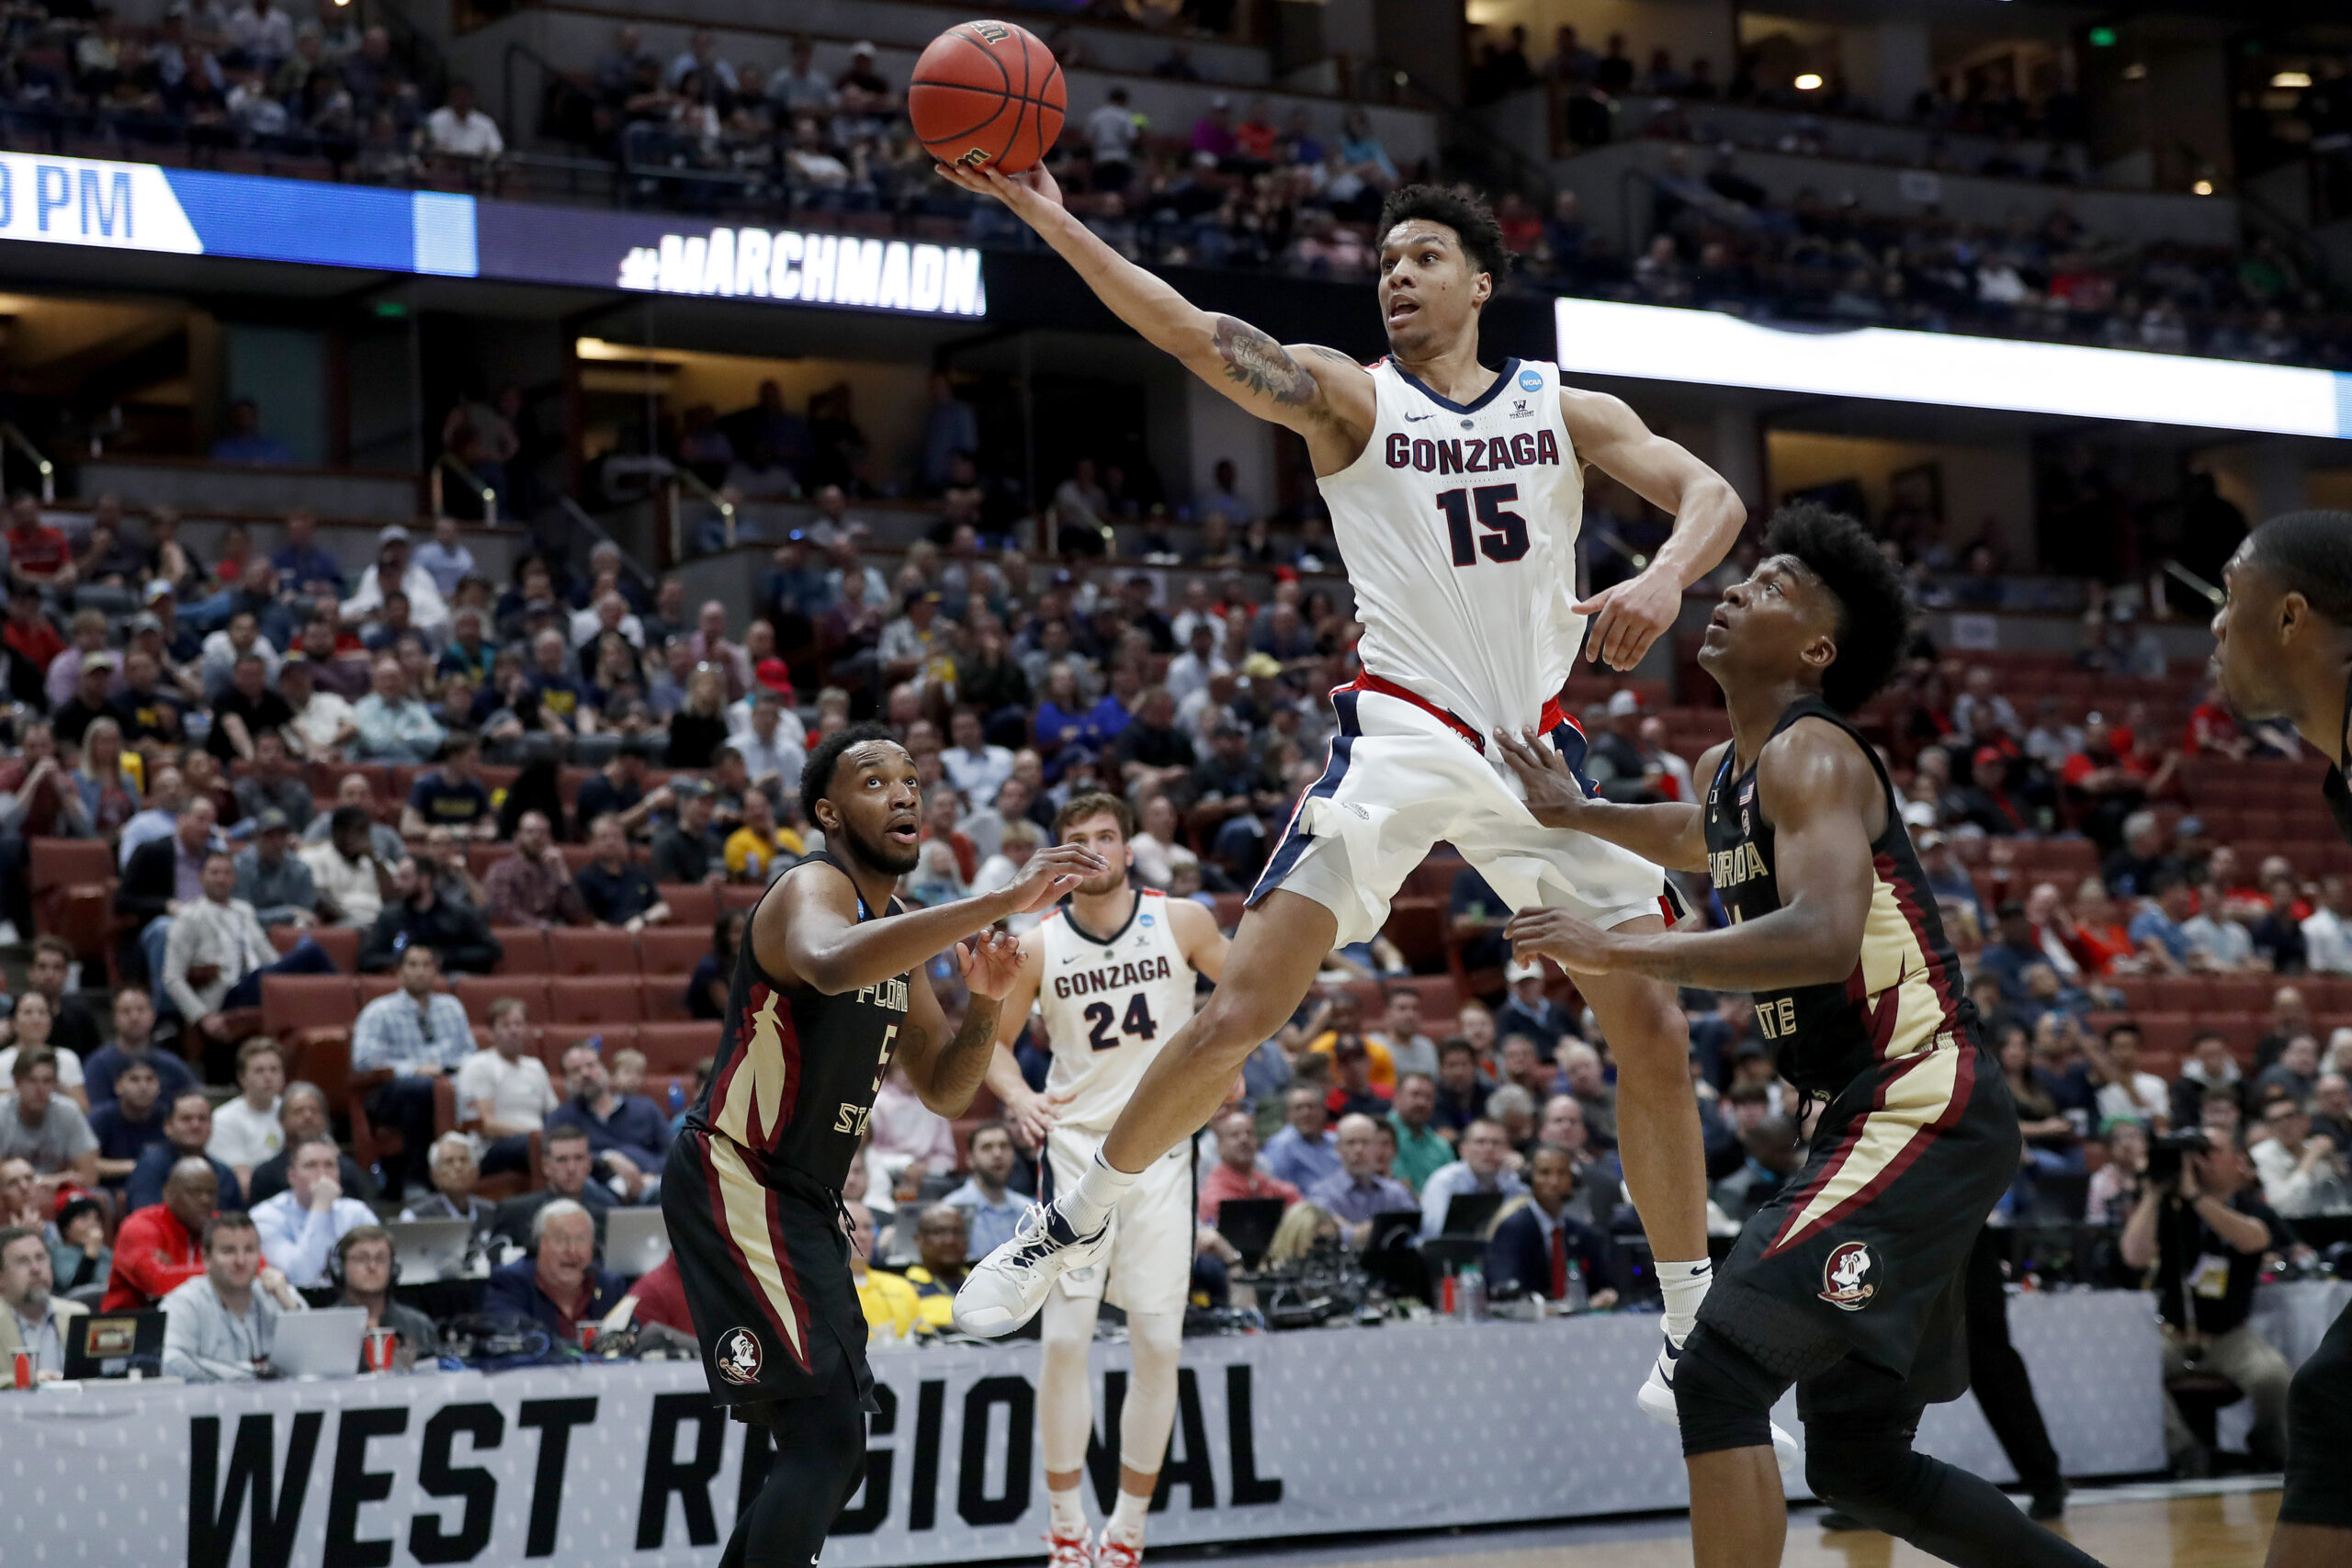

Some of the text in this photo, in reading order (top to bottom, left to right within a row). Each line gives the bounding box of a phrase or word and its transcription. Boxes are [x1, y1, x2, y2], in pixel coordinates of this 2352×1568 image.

[37, 164, 133, 238] PM
[1385, 429, 1560, 476] GONZAGA
[1436, 483, 1531, 567] 15
[1055, 956, 1170, 998] GONZAGA
[1084, 993, 1158, 1052] 24
[187, 1365, 1283, 1568] WEST RGIONAL
